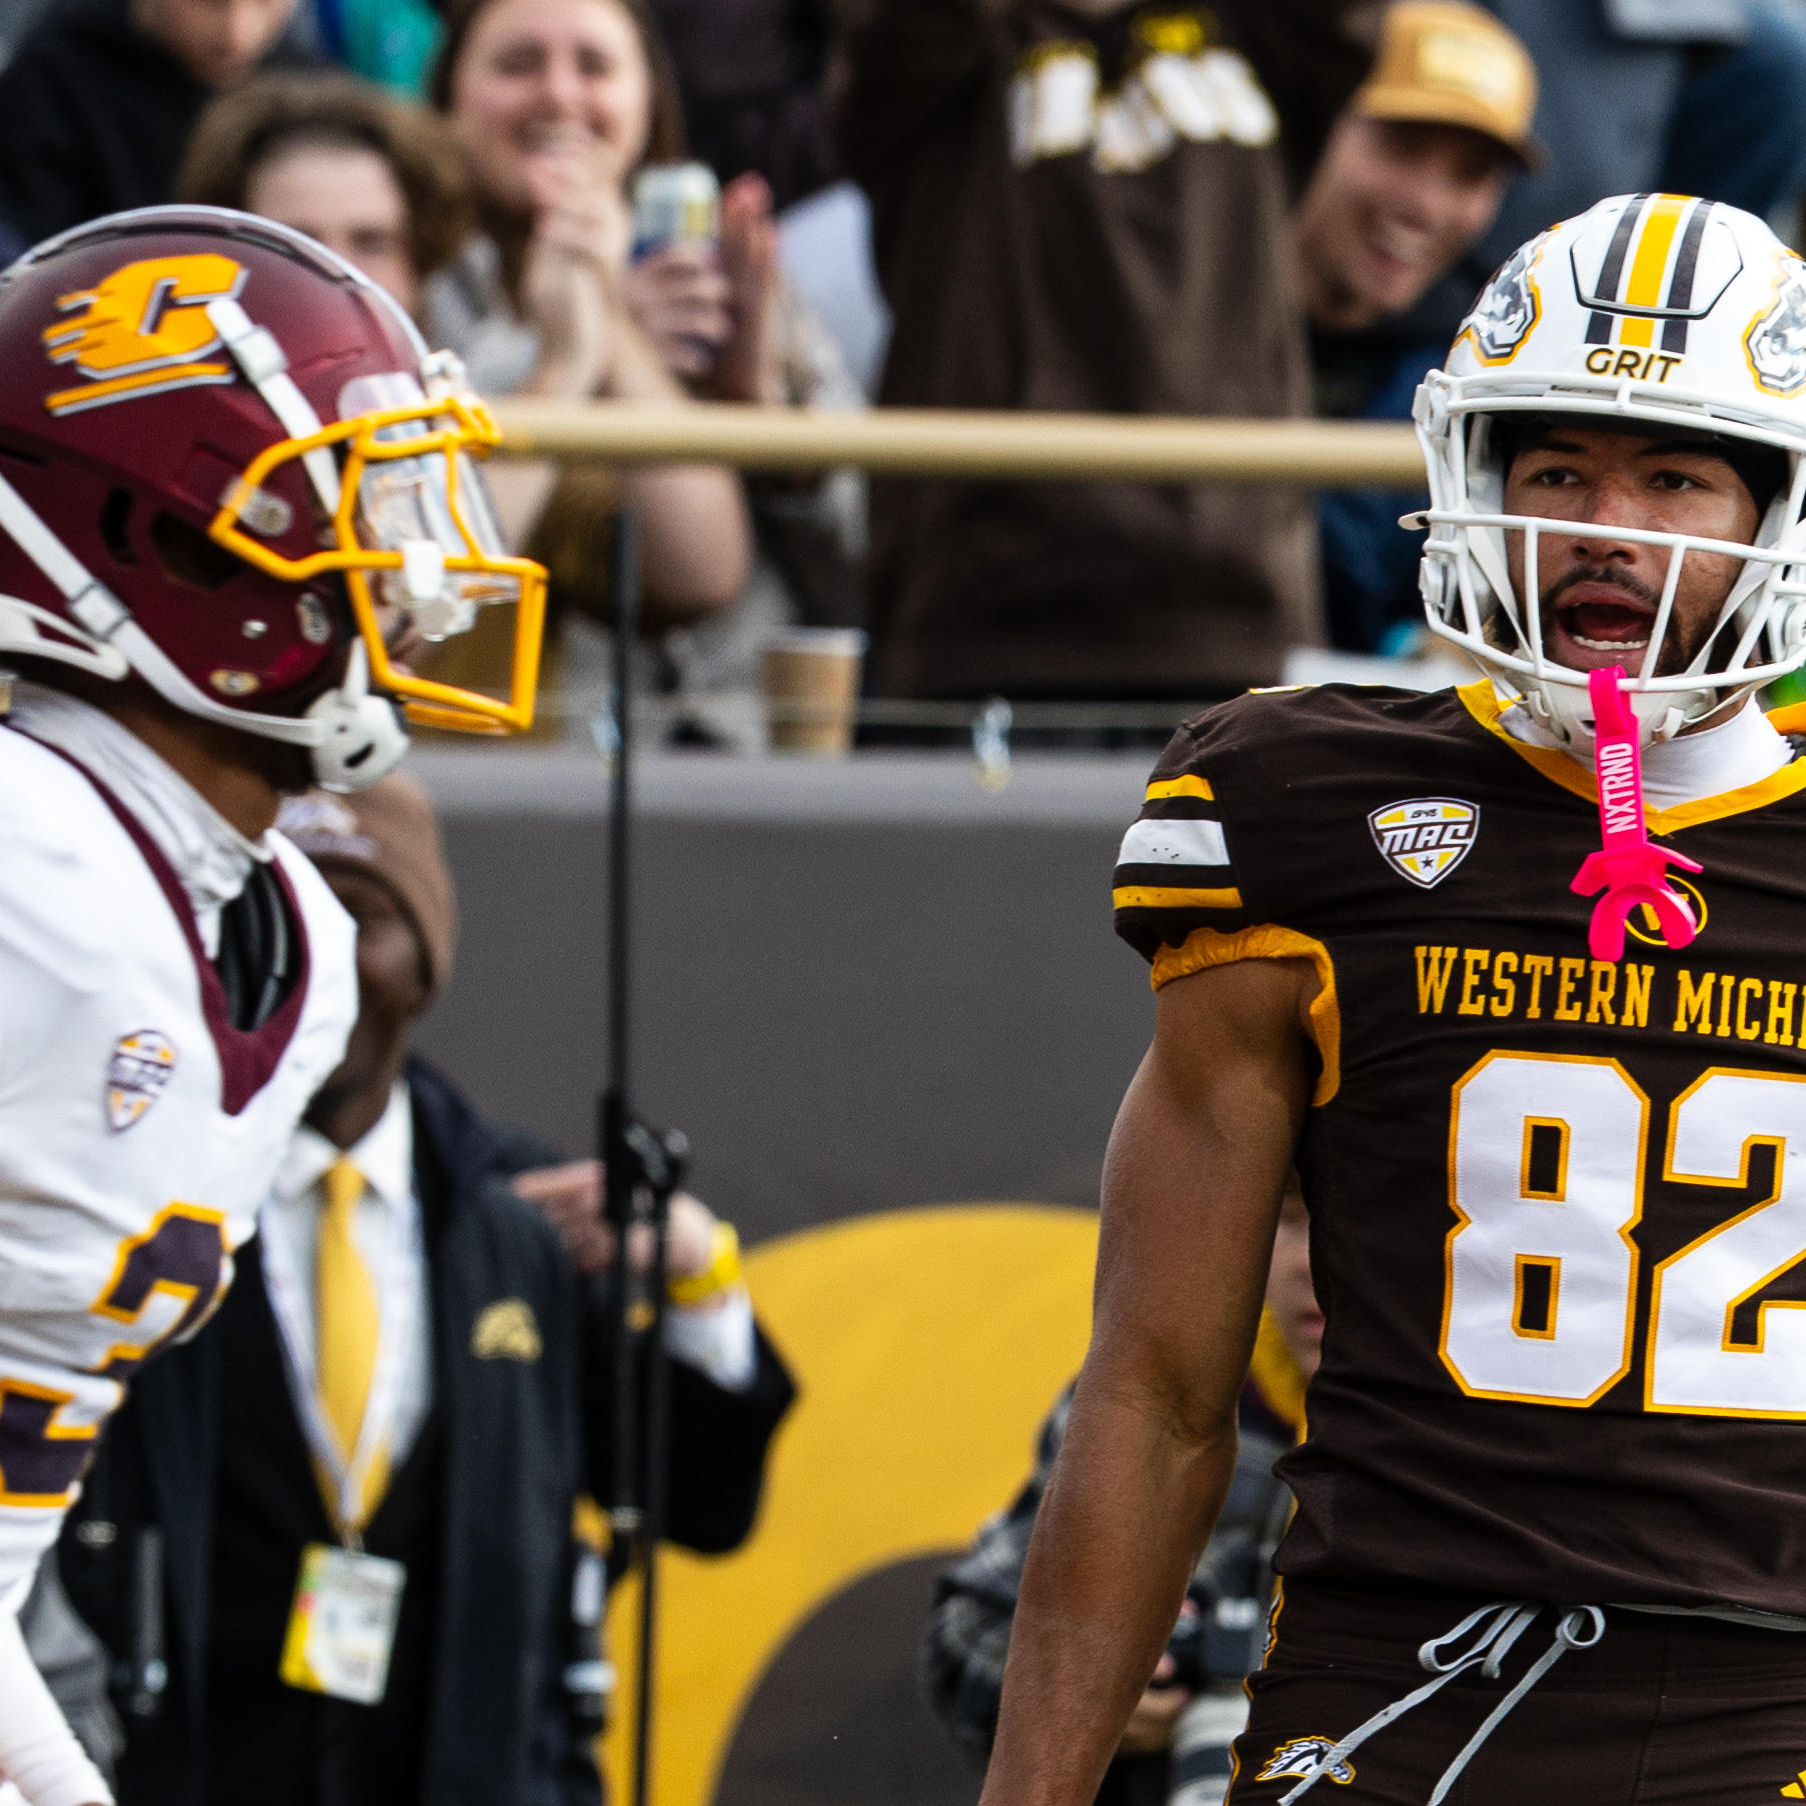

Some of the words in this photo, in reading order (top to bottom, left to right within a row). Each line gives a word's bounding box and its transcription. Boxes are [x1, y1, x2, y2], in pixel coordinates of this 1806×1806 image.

[1586, 347, 1682, 383] GRIT
[1599, 742, 1639, 835] NXTRND
[1382, 824, 1474, 856] MAC
[1414, 946, 1655, 1028] WESTERN
